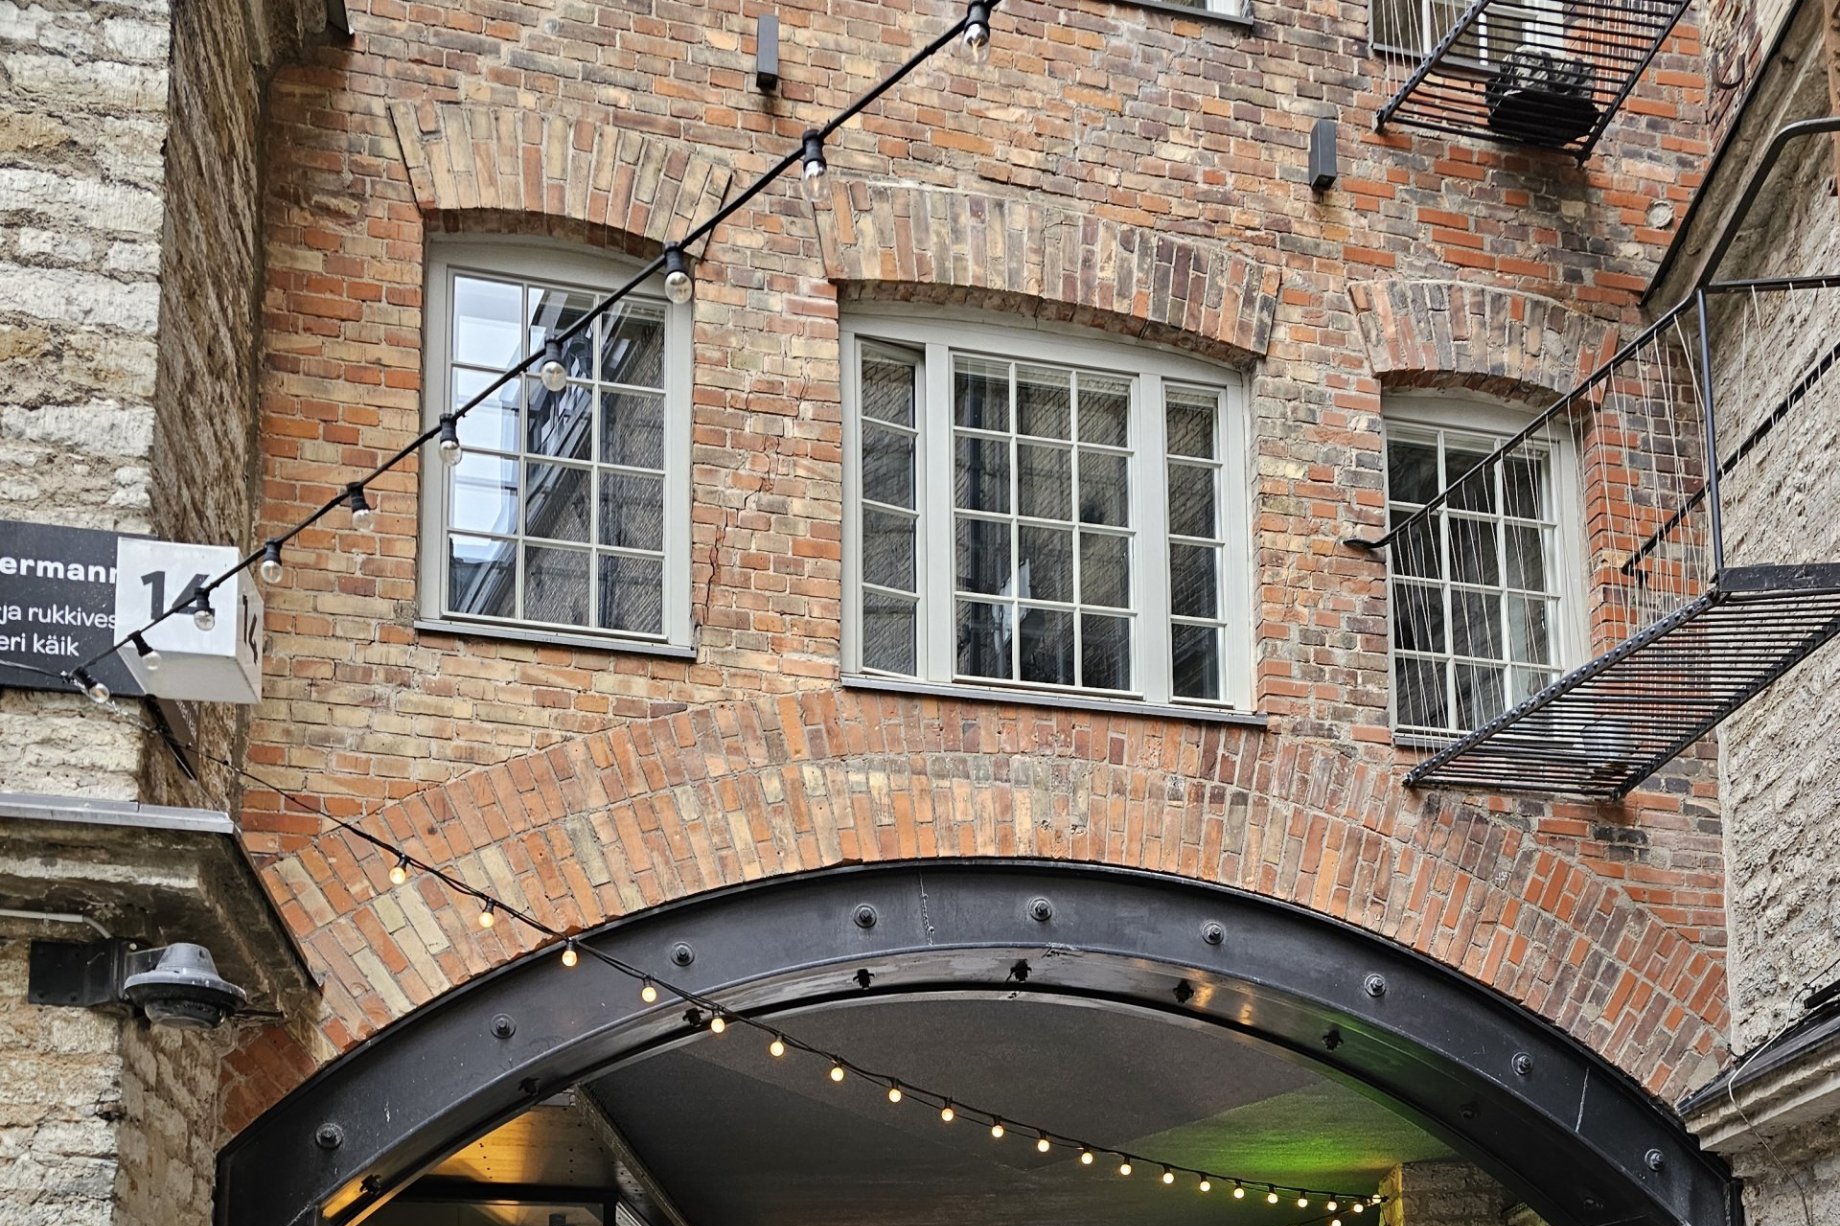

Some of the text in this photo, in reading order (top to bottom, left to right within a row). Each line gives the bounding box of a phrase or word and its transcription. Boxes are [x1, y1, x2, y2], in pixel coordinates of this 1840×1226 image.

[140, 570, 216, 622] 14
[0, 604, 21, 625] ja
[33, 632, 79, 657] käik
